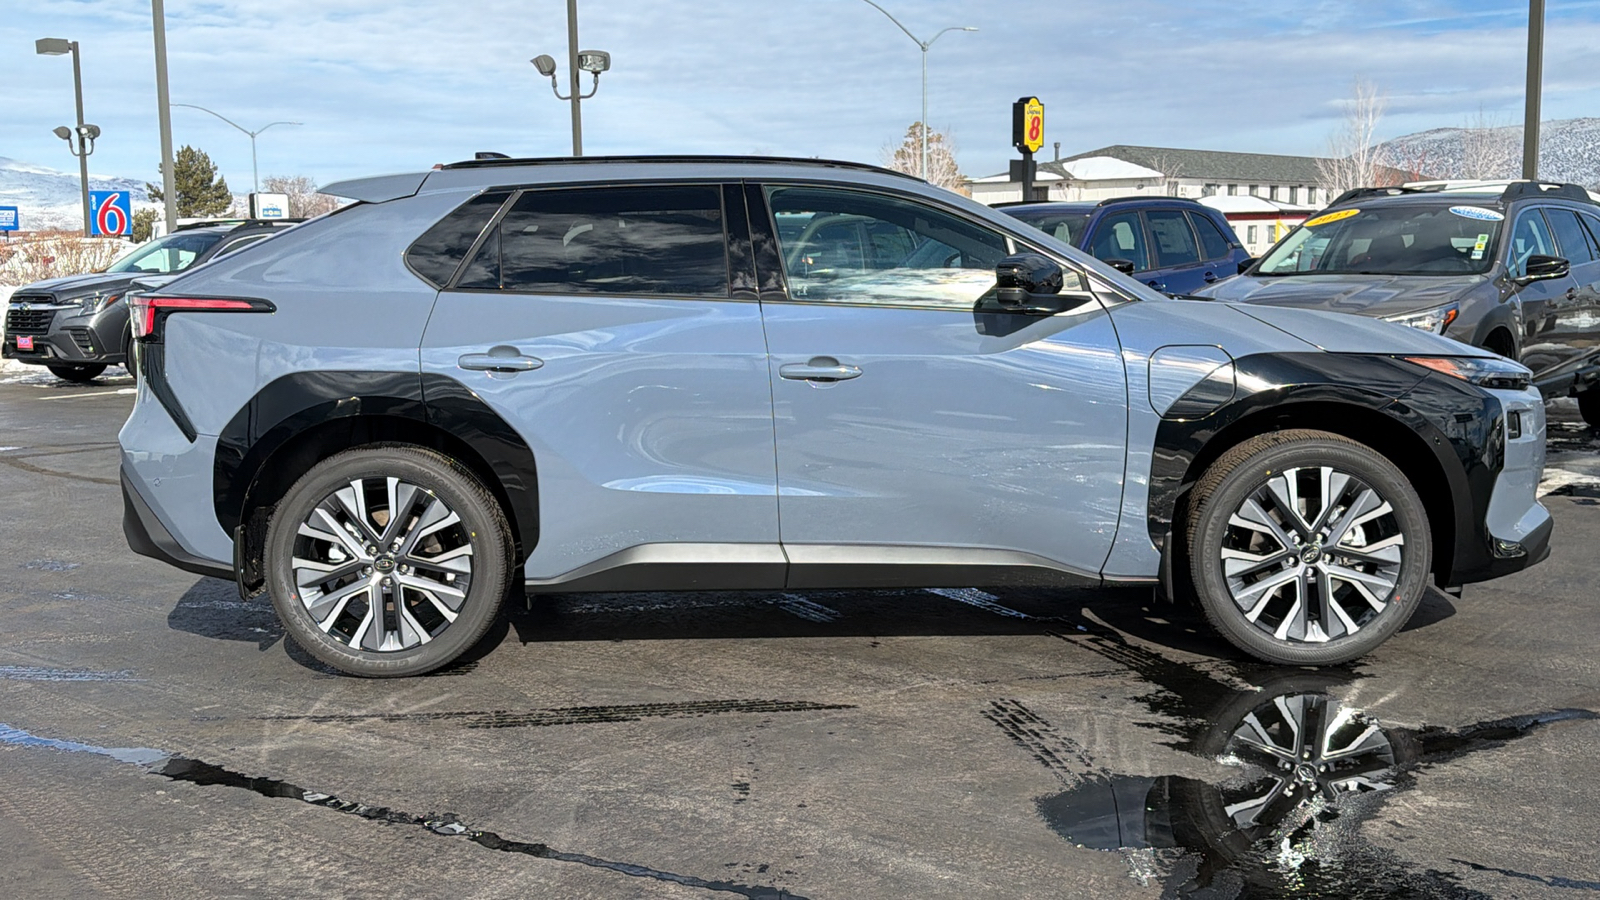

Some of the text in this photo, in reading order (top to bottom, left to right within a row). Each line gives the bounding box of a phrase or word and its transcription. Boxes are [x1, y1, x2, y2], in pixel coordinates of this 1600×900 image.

[1028, 116, 1041, 141] 8
[97, 193, 127, 235] 6
[1204, 512, 1220, 576] YOKOHAMA
